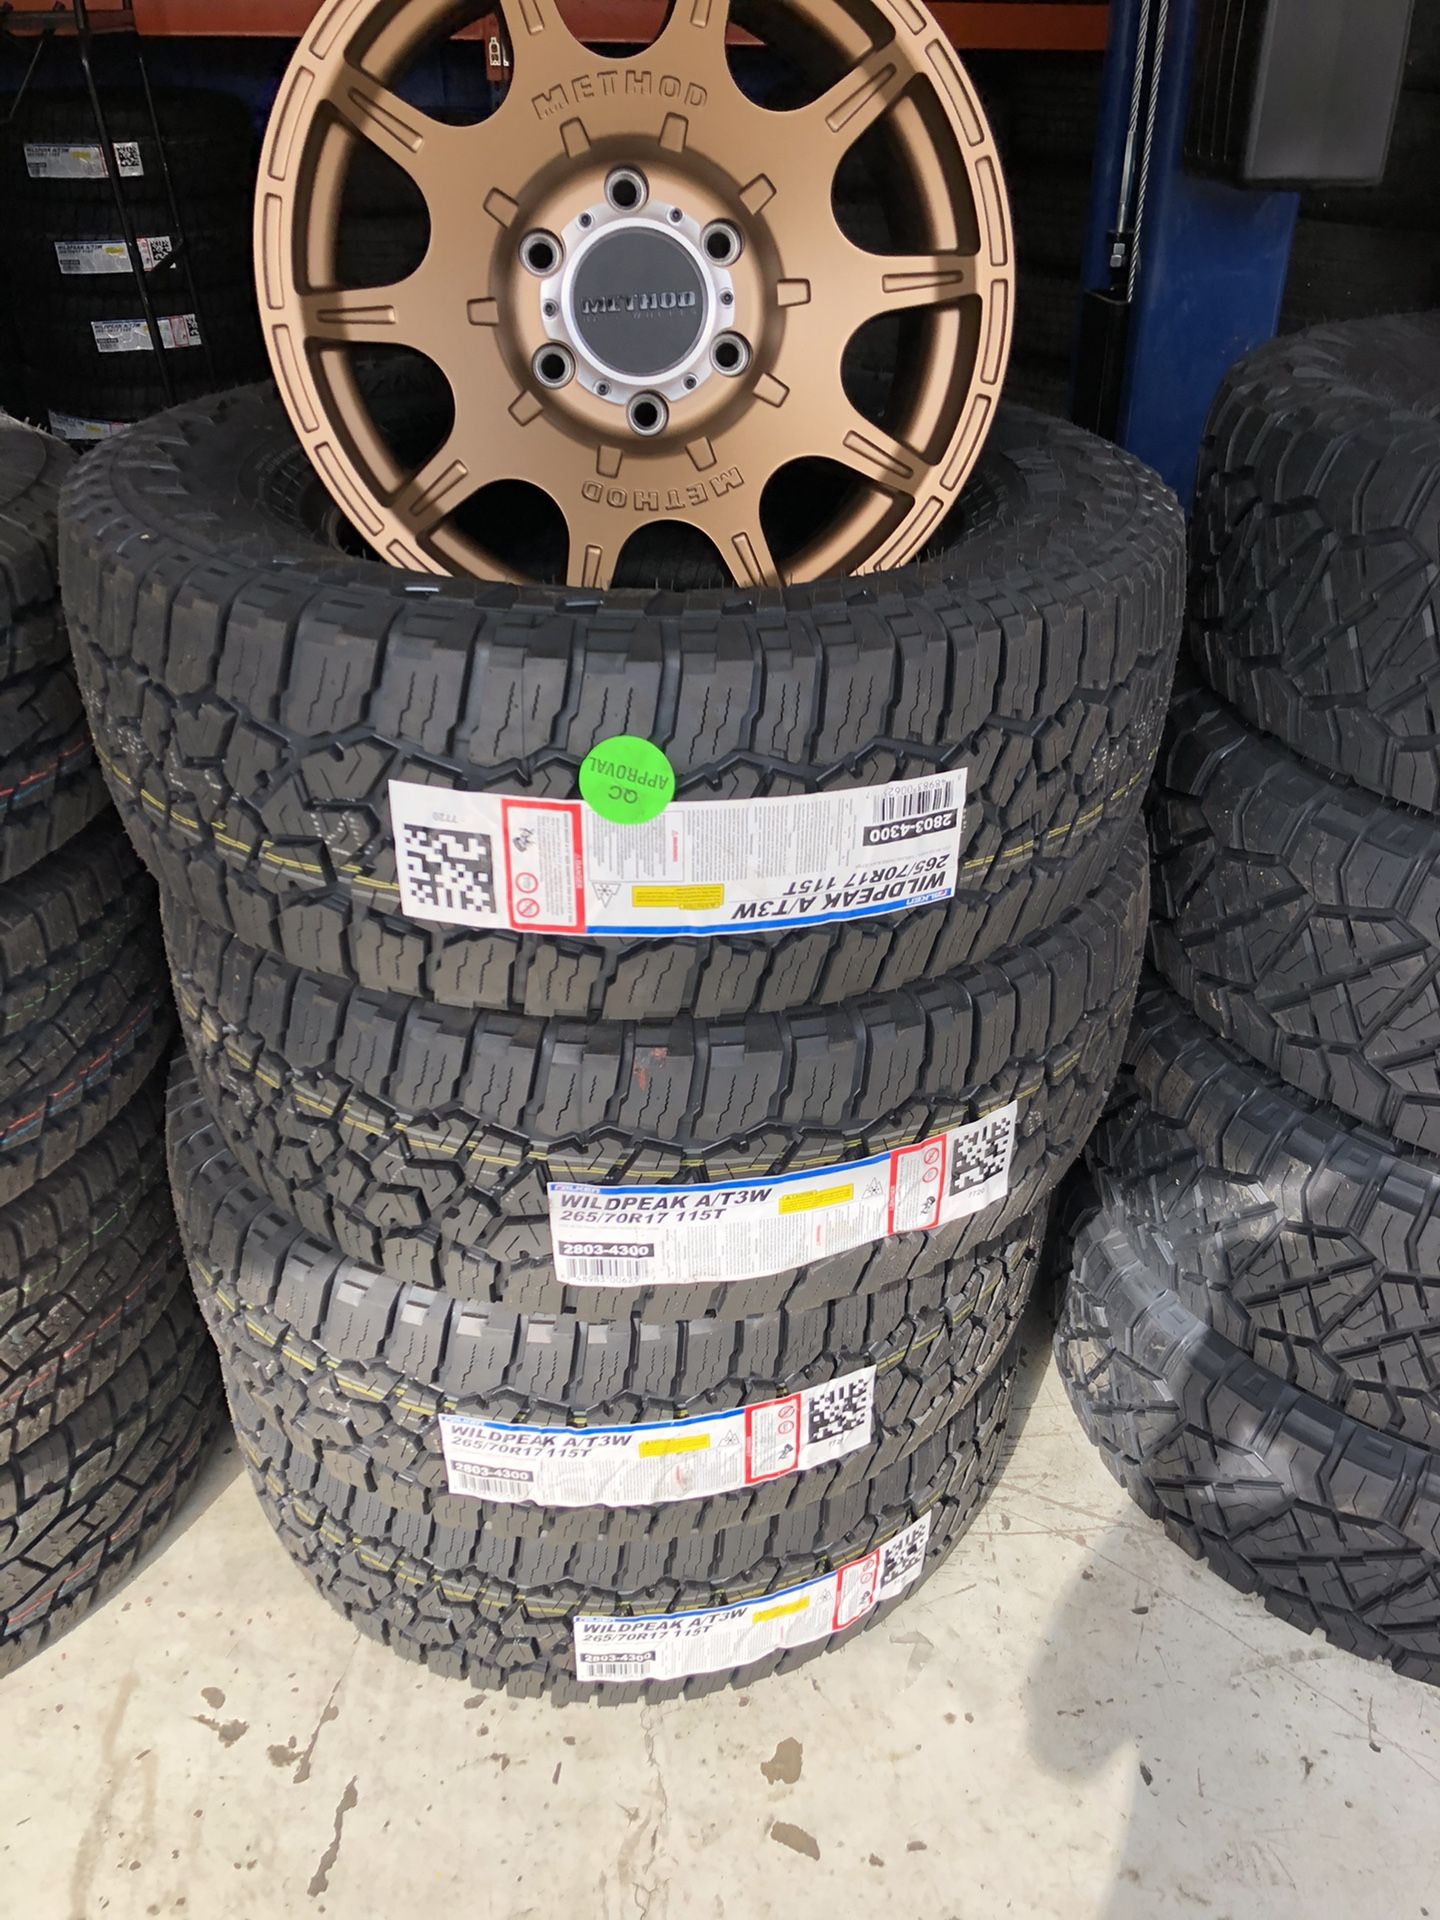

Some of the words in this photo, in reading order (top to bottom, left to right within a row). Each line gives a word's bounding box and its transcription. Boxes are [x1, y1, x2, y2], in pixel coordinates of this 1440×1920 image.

[531, 70, 708, 120] METHOD
[582, 291, 696, 314] METHOD
[582, 466, 744, 511] METHOD
[589, 756, 669, 791] APPROVAL
[608, 785, 639, 804] QC
[869, 813, 953, 843] 2803-4300
[845, 854, 950, 886] 265/70R17
[782, 876, 836, 897] 115T
[822, 870, 946, 911] WILDPEAK
[731, 896, 817, 919] A/T3W
[561, 1194, 688, 1212] WILDPEAK
[695, 1188, 773, 1208] A/T3W
[560, 1210, 669, 1224] 265/70R17
[676, 1208, 727, 1222] 115T
[563, 1244, 649, 1257] 2803-4300
[451, 1425, 554, 1446] WILDPEAK
[562, 1434, 633, 1448] A/T3W
[451, 1436, 541, 1457] 265/70R17
[547, 1448, 592, 1458] 115T
[454, 1462, 529, 1480] 2803-4300
[583, 1620, 682, 1633] WILDPEAK
[688, 1607, 748, 1627] A/T3W
[583, 1631, 668, 1642] 265/70R17
[674, 1625, 712, 1638] 115T
[584, 1652, 652, 1663] 2803-4300
